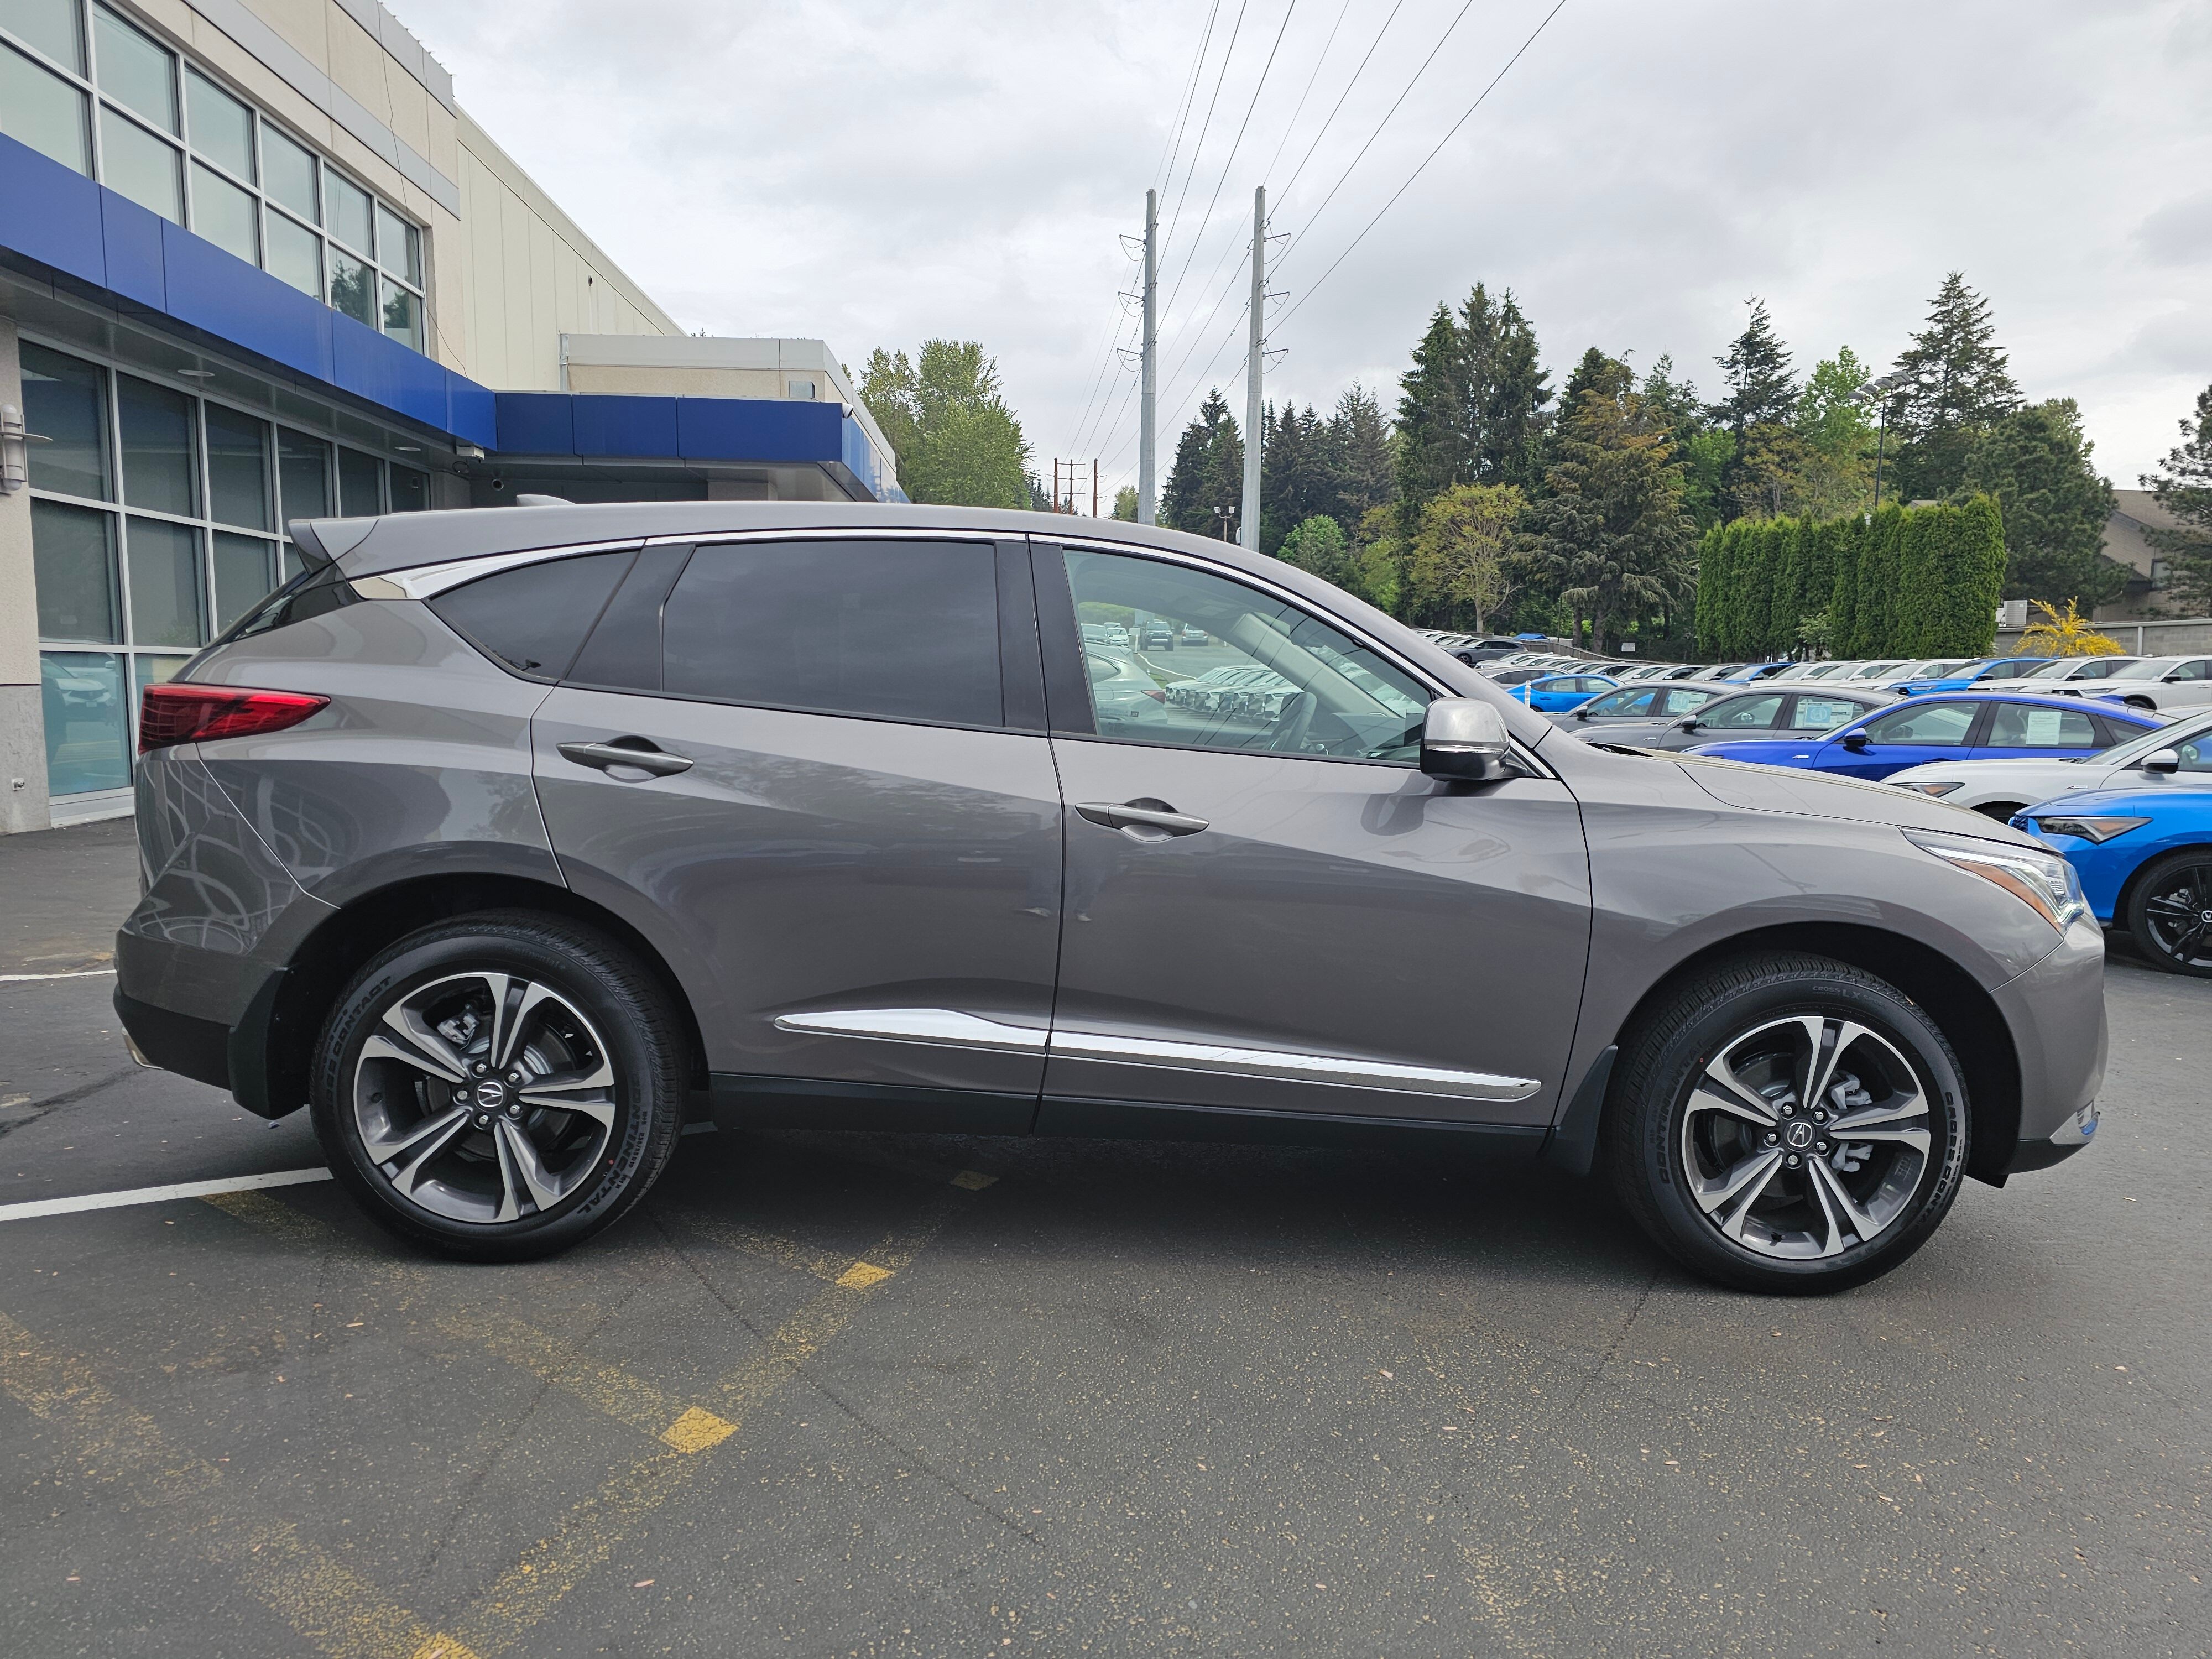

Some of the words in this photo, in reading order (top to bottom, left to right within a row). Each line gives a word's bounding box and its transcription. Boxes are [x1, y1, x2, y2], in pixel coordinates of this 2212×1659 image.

[333, 976, 391, 1057] CONTACT
[1842, 989, 1860, 1000] LX
[577, 1071, 641, 1214] CONTINENTAL
[1945, 1092, 1957, 1162] CROSS
